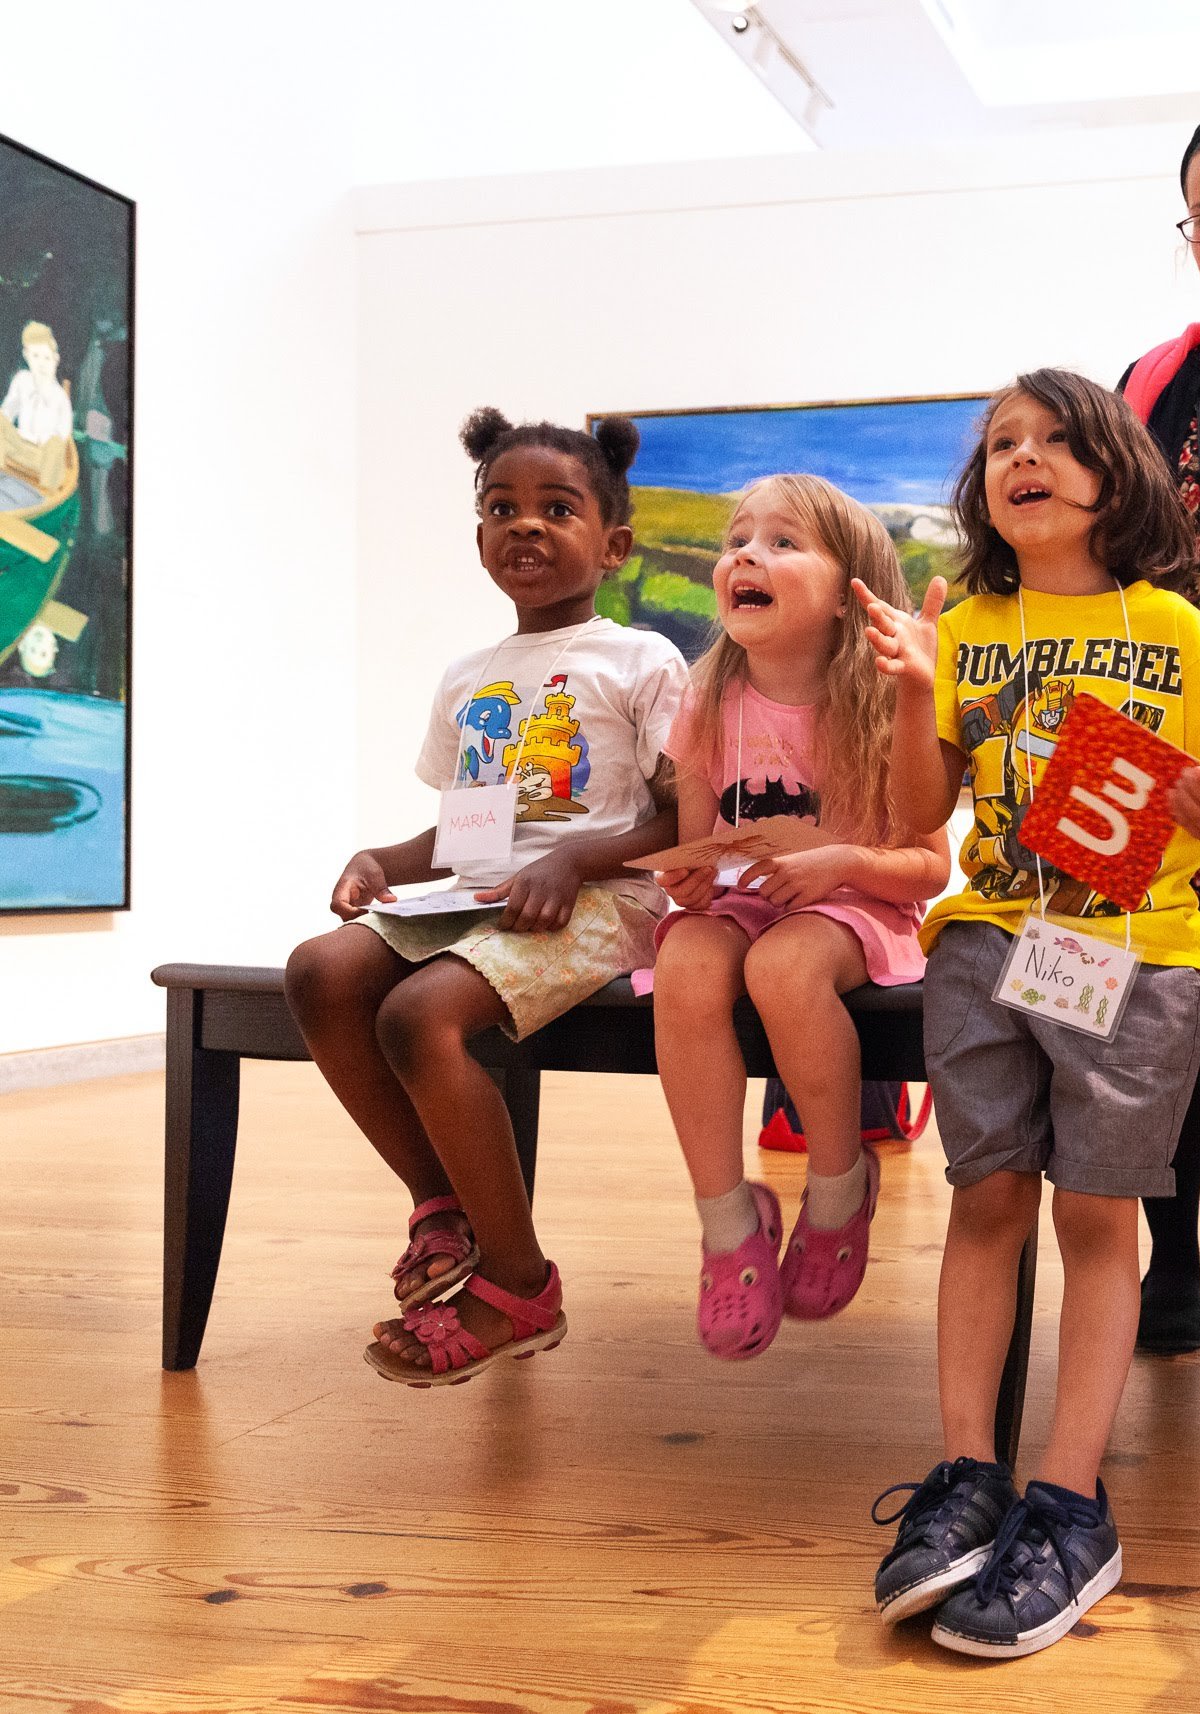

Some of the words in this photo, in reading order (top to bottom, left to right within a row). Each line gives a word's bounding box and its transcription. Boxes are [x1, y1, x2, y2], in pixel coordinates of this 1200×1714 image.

[957, 638, 1182, 696] BUMBLEBEE
[450, 810, 496, 832] MARIA
[1056, 757, 1156, 856] Uu
[1025, 944, 1075, 987] Niko
